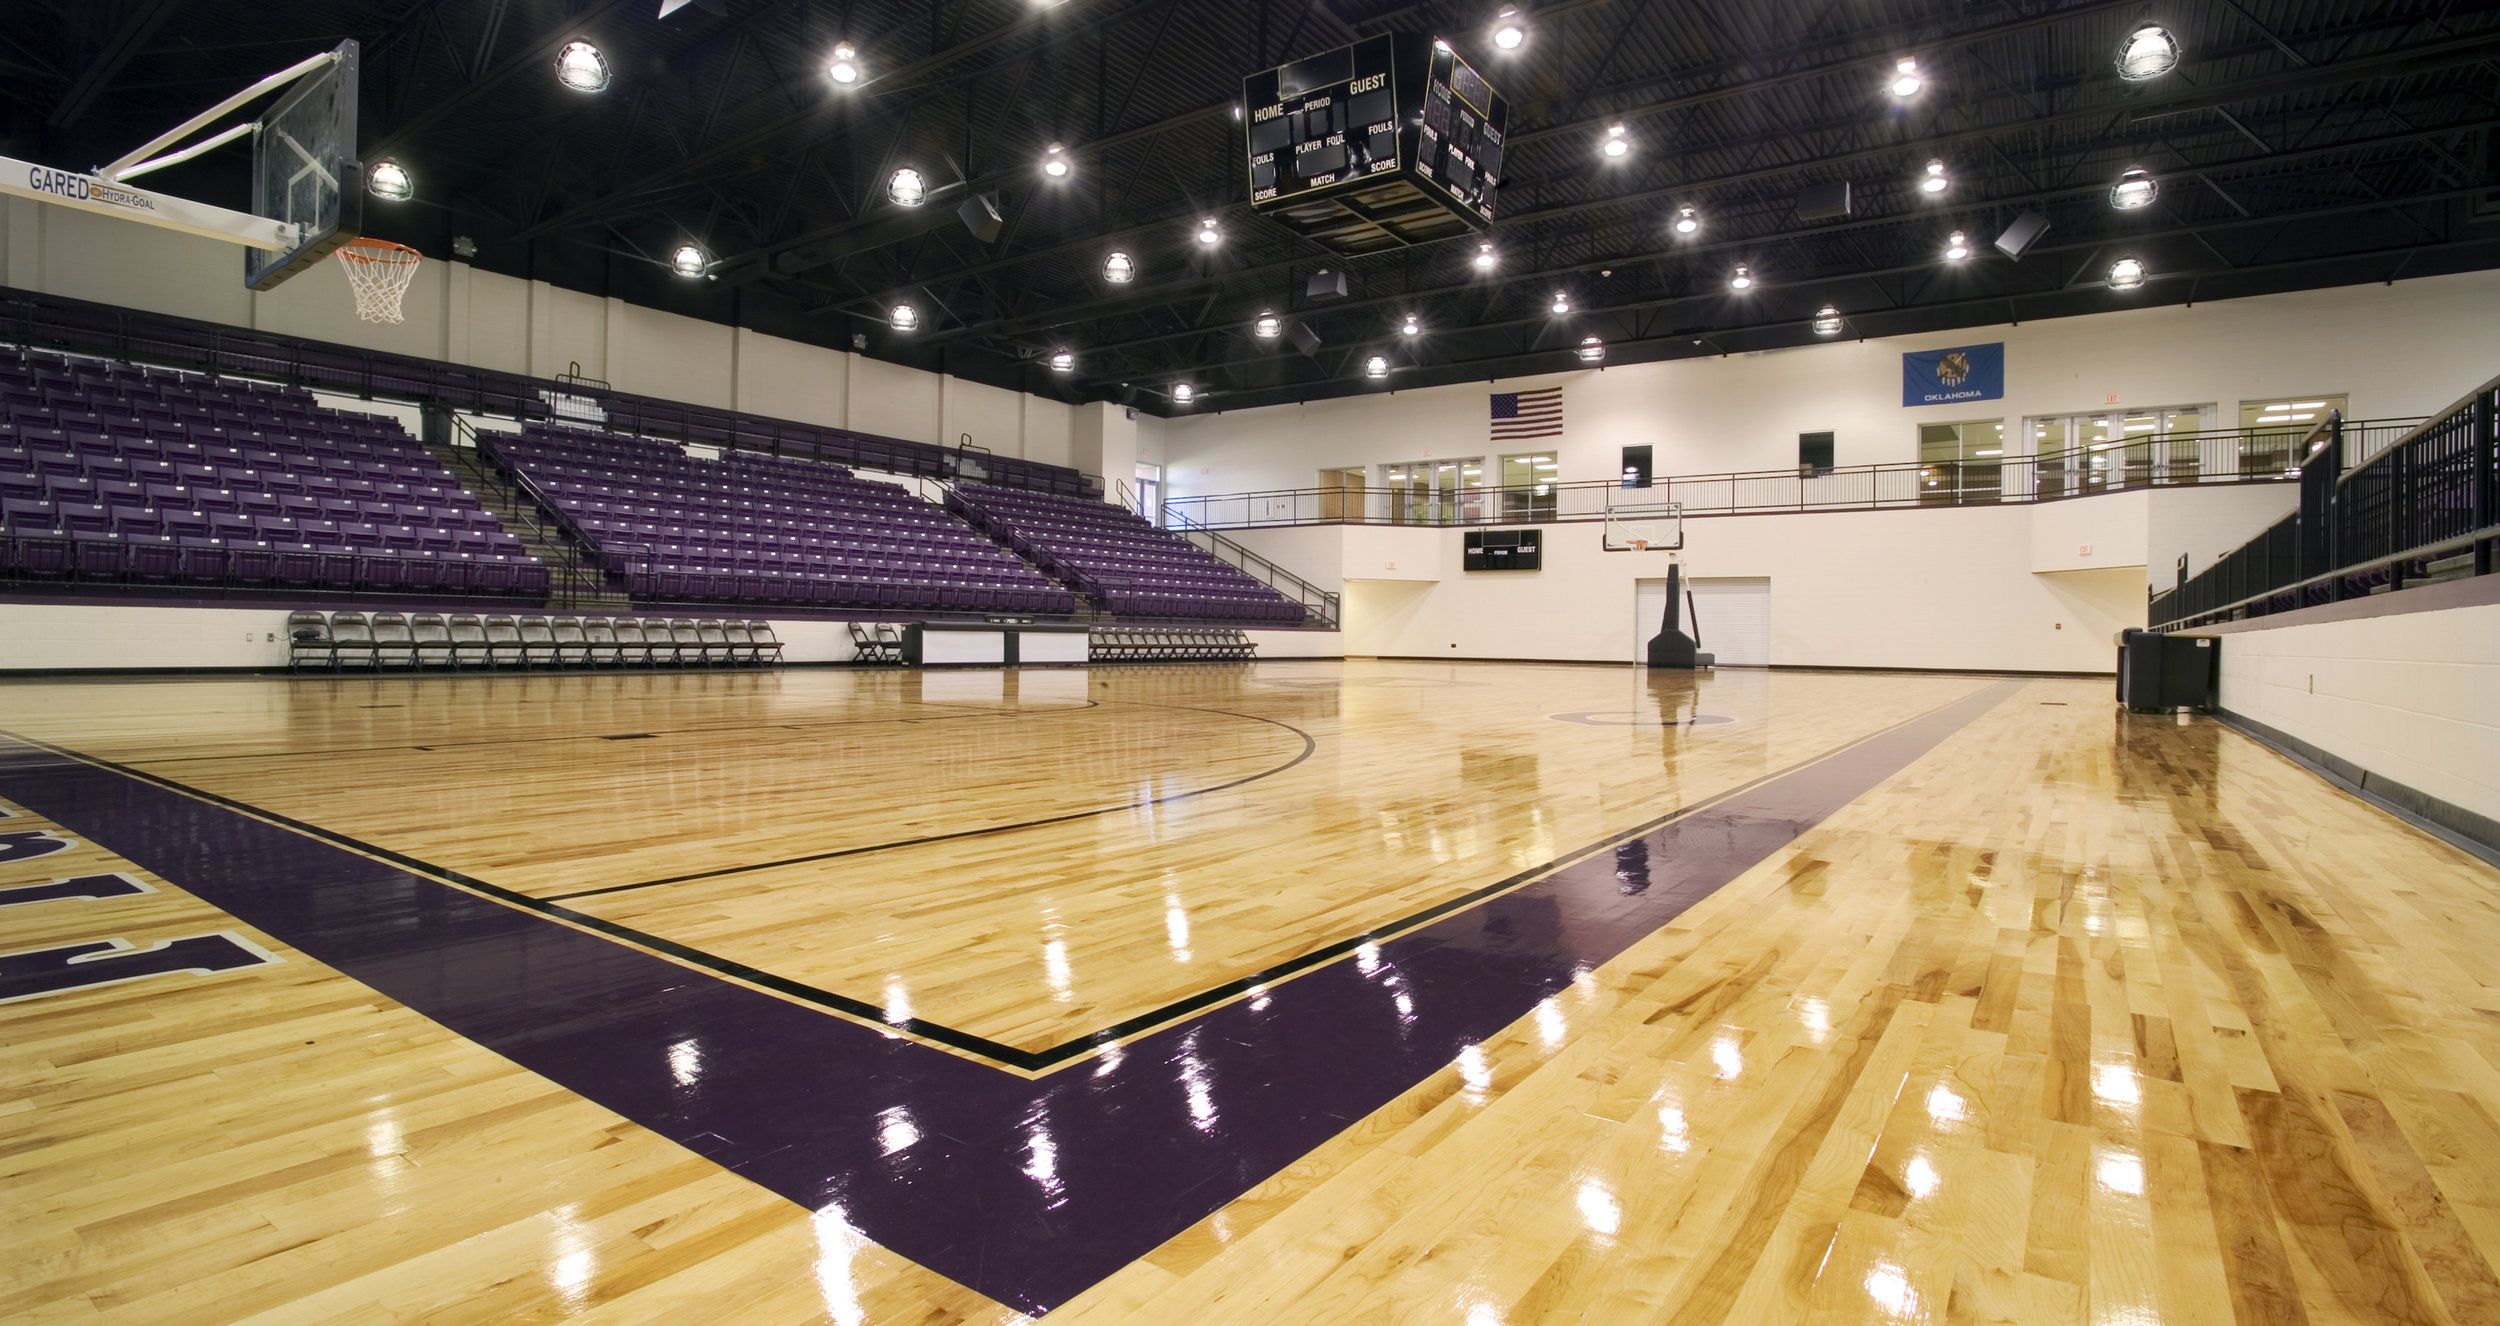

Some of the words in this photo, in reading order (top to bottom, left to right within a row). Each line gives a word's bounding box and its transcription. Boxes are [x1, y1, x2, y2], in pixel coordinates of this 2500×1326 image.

[1350, 73, 1386, 95] GUEST
[1304, 97, 1331, 112] PERIOD
[1254, 103, 1284, 123] HOME
[1368, 121, 1393, 136] FOULS
[1295, 140, 1322, 155] PLAYER
[1326, 134, 1346, 147] FOUL
[1252, 152, 1275, 165] FOULS
[1370, 158, 1396, 173] SCORE
[1310, 173, 1335, 188] MATCH
[29, 167, 89, 200] GARED
[102, 189, 155, 210] HYDRA-GOAL
[1254, 188, 1277, 201] SCORE
[1924, 390, 1982, 401] OKLAHOMA
